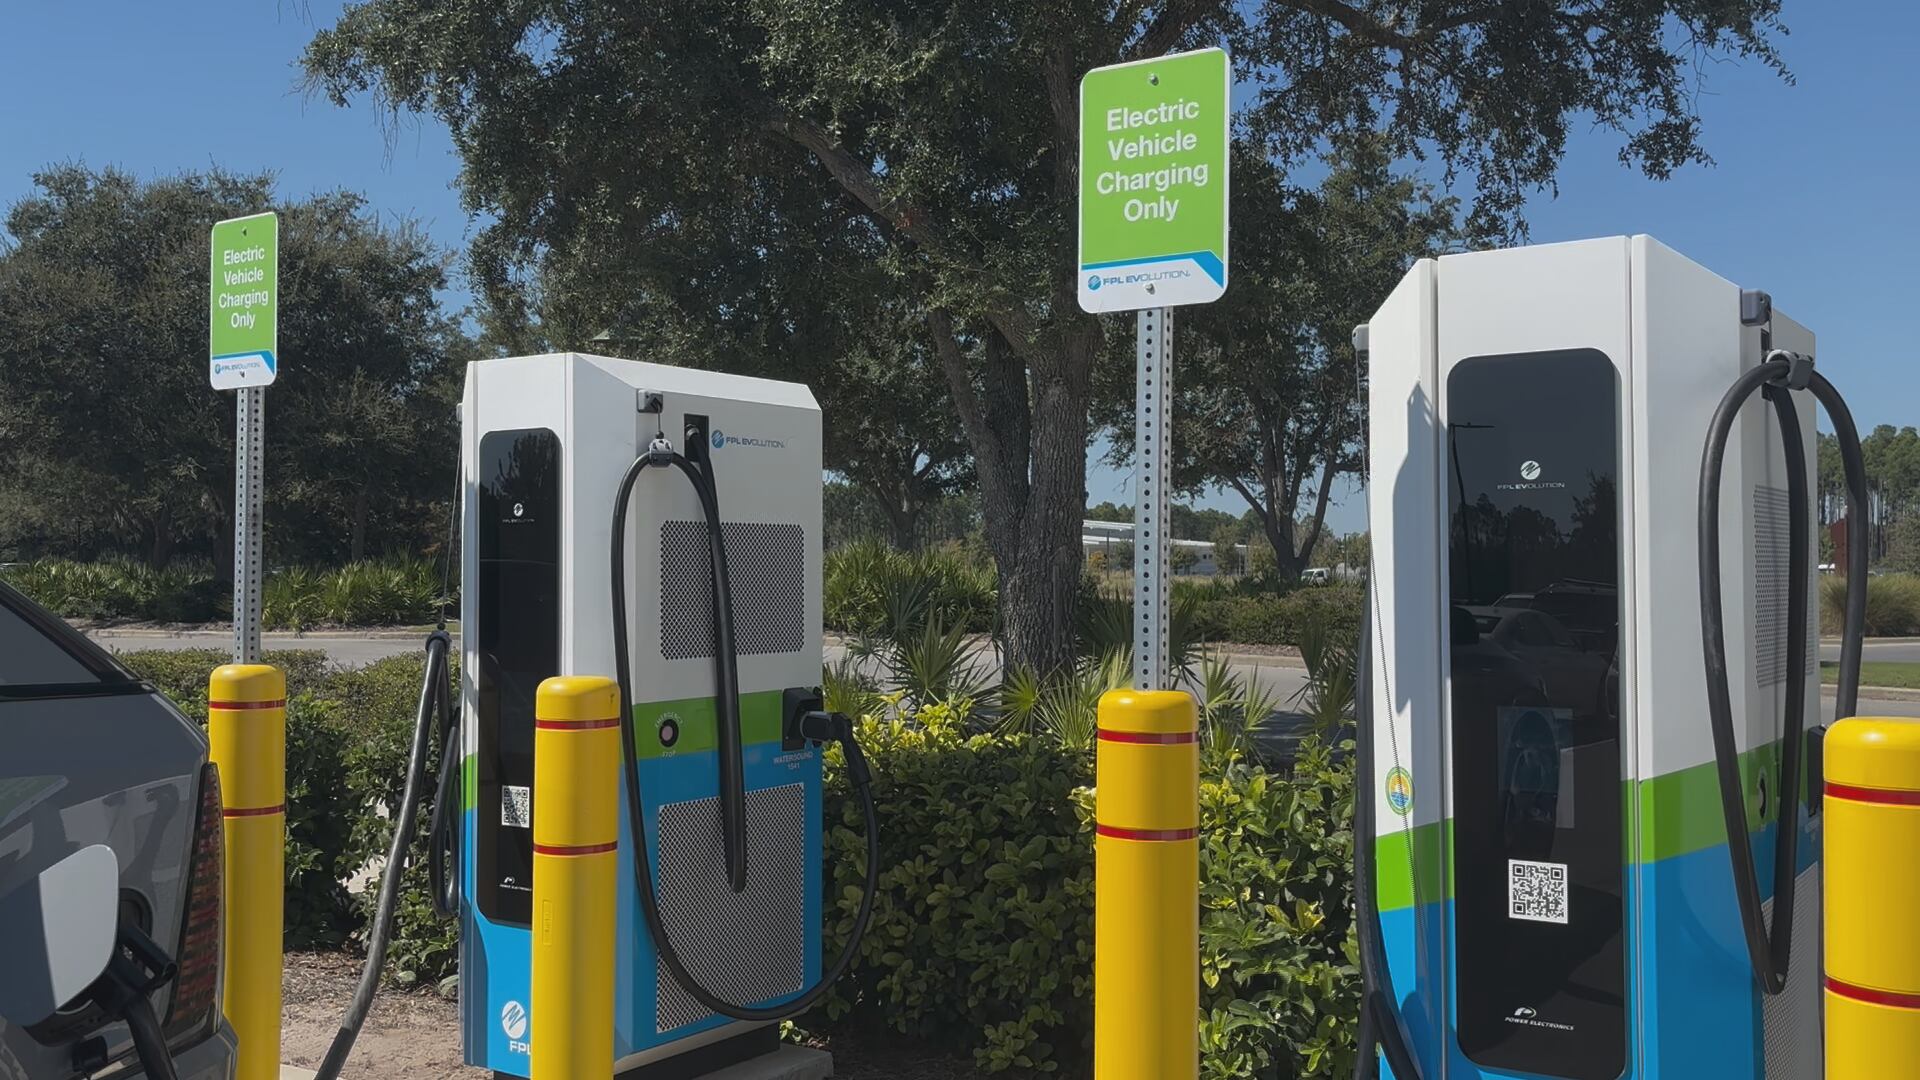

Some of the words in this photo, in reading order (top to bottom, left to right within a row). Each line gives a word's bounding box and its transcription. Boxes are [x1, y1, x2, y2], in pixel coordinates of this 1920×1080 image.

[1107, 98, 1199, 132] Electric
[1108, 130, 1198, 161] Vehicle
[1096, 163, 1209, 195] Charging
[1124, 195, 1180, 222] Only
[224, 245, 265, 265] Electric
[224, 266, 264, 286] Vehicle
[1103, 276, 1125, 285] FPL
[218, 289, 269, 309] Charging
[231, 311, 256, 329] Only
[726, 436, 741, 445] FPL
[1515, 482, 1565, 490] EVOLUTION
[1504, 1016, 1529, 1025] POWER
[1529, 1020, 1575, 1031] ELECTRONICS
